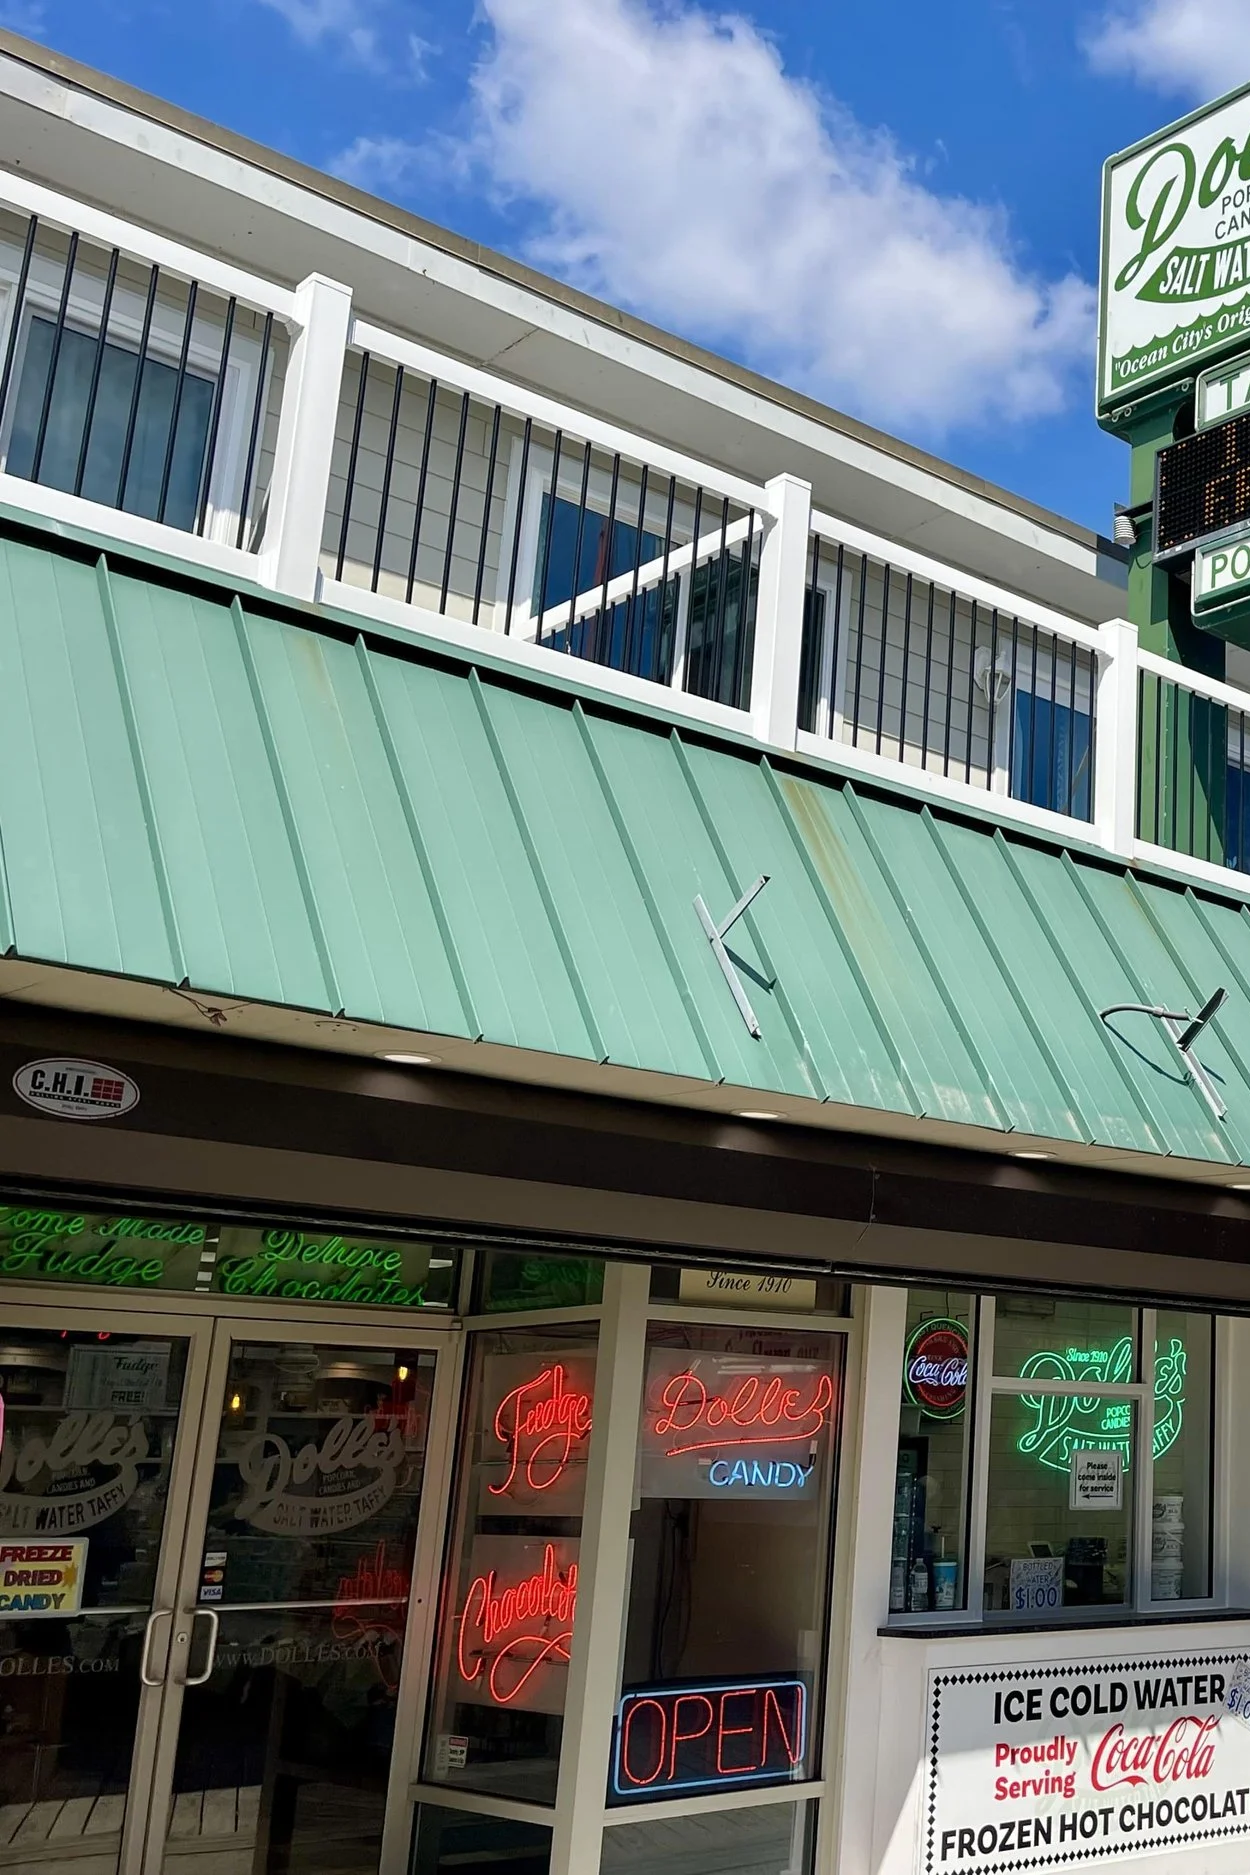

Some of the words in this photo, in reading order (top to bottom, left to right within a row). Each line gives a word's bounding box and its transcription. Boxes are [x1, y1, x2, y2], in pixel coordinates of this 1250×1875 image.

[1159, 251, 1212, 296] SALT
[1171, 321, 1213, 358] City's
[30, 1069, 90, 1097] C.H.I.
[99, 1216, 205, 1245] Made
[3, 1231, 164, 1285] Fudge
[257, 1229, 402, 1270] Deluxe
[221, 1256, 430, 1306] Chocolates
[706, 1270, 751, 1291] Since
[756, 1275, 793, 1295] 1910
[1066, 1346, 1090, 1362] Since
[1101, 1417, 1131, 1431] CANDIE
[1153, 1418, 1175, 1454] AFFY
[709, 1460, 815, 1488] CANDY
[1077, 1473, 1096, 1482] come
[1096, 1472, 1116, 1482] inside
[1086, 1461, 1108, 1470] Please
[355, 1486, 386, 1515] TAFFY
[1079, 1484, 1090, 1493] for
[1090, 1484, 1114, 1493] service
[35, 1501, 85, 1530] WATER
[87, 1483, 126, 1517] TAFFY
[0, 1545, 74, 1562] FREEZE
[1022, 1562, 1053, 1571] BOTTLED
[3, 1569, 63, 1587] DRIED
[203, 1588, 222, 1597] VISA
[0, 1593, 66, 1611] CANDY
[1015, 1587, 1058, 1610] $1.00
[993, 1688, 1043, 1724] ICE
[1049, 1682, 1128, 1719] COLD
[1133, 1673, 1226, 1711] WATER
[623, 1686, 801, 1785] OPEN
[995, 1735, 1078, 1767] Proudly
[1091, 1713, 1223, 1791] Coca-Cola
[994, 1768, 1077, 1801] Serving
[940, 1815, 1053, 1861] FROZEN
[1058, 1807, 1115, 1843] HOT
